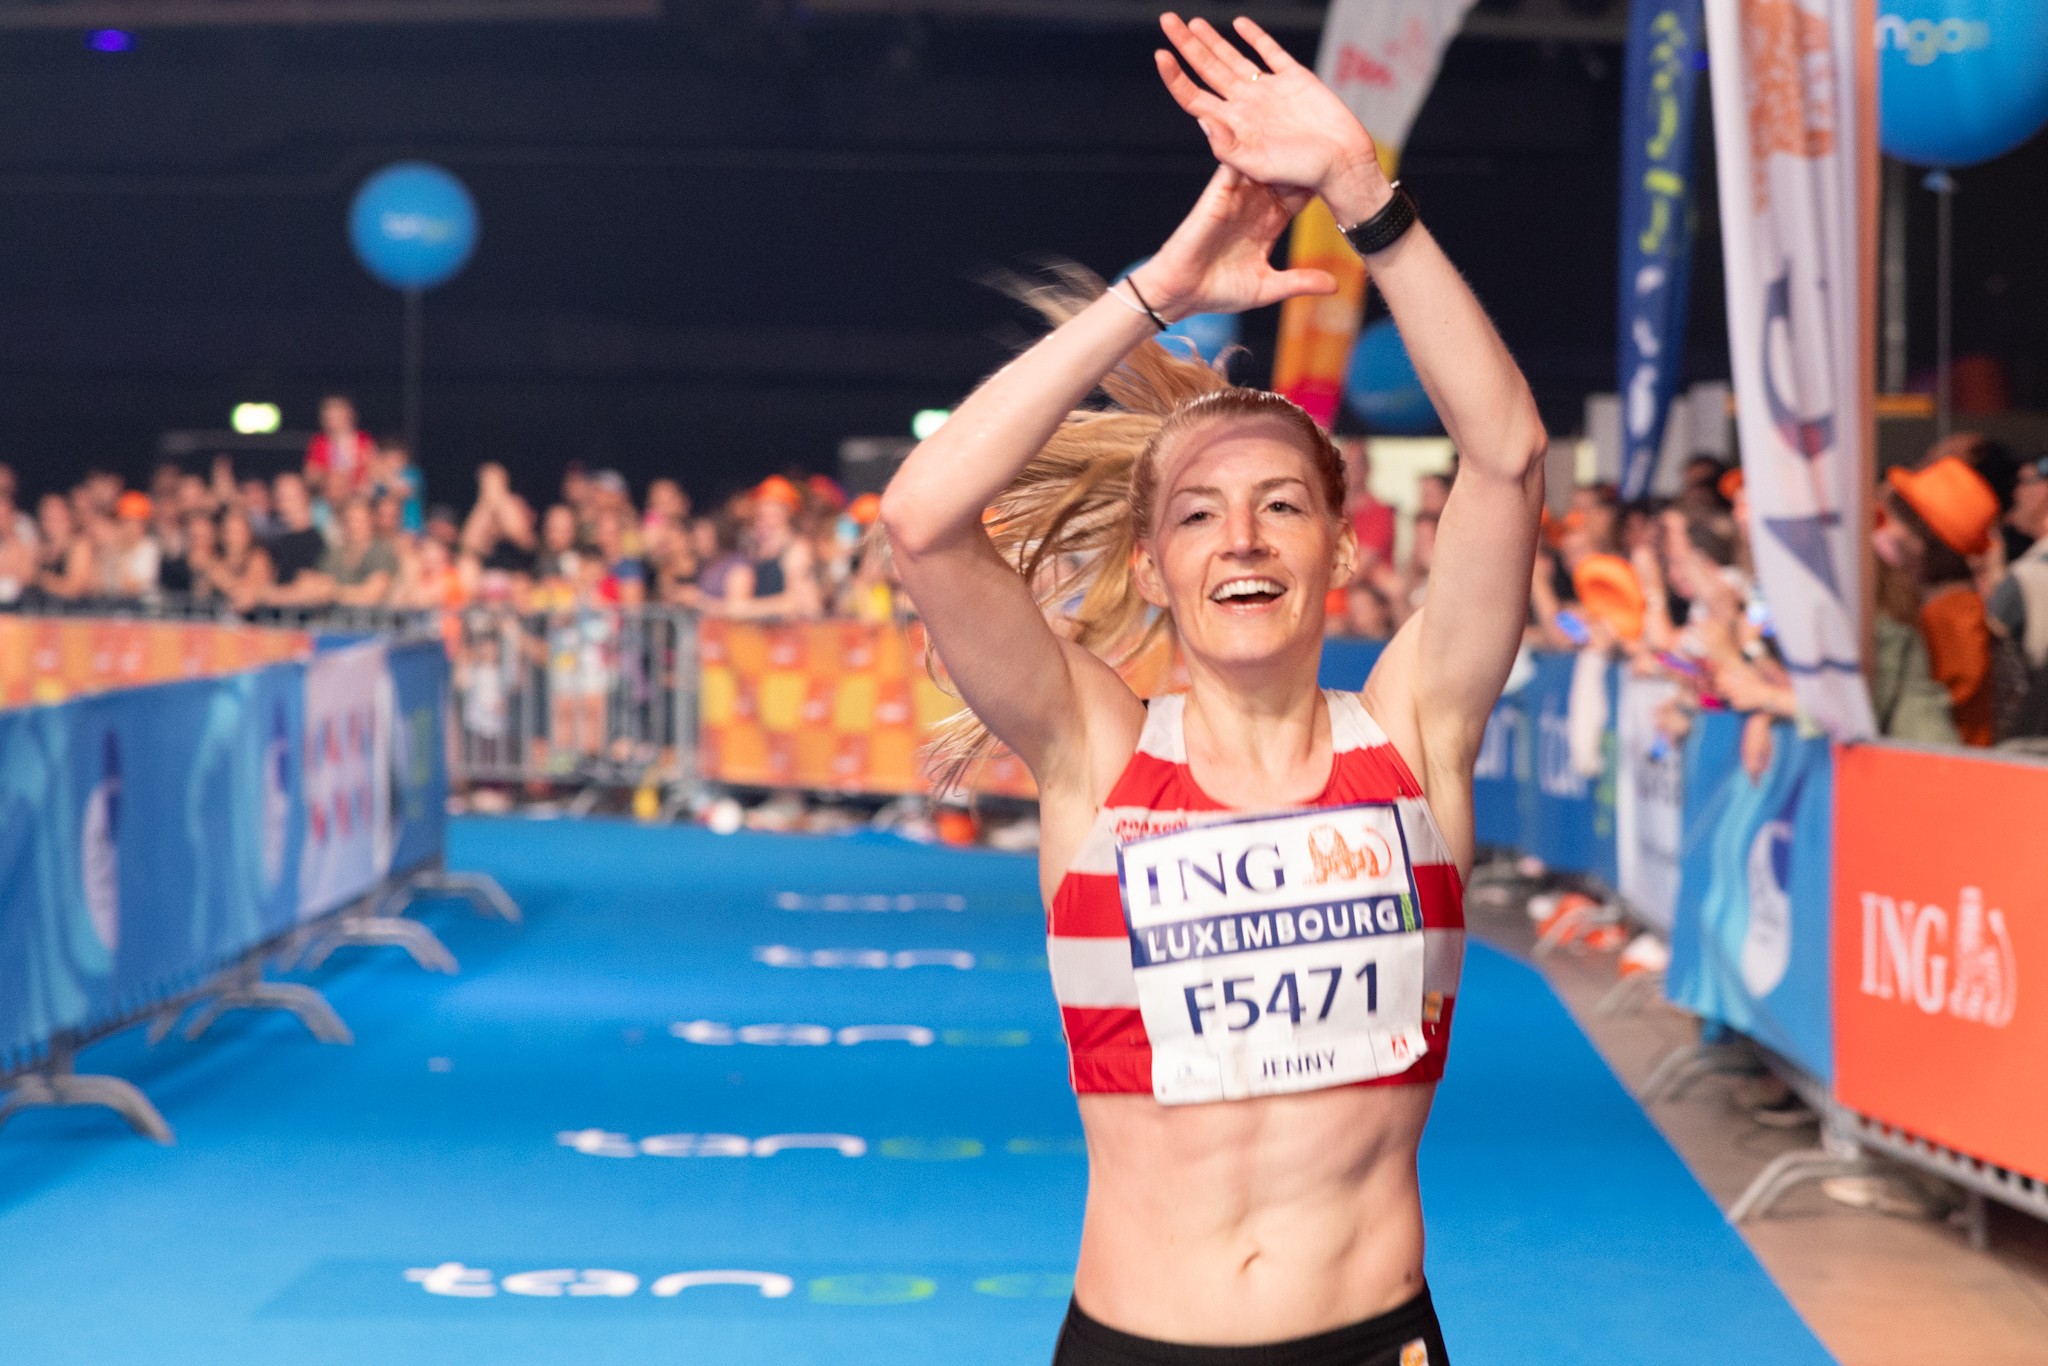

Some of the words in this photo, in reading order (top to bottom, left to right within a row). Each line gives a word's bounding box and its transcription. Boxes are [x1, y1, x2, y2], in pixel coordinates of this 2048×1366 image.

[1145, 842, 1288, 908] ING
[1147, 897, 1400, 964] LUXEMBOURG
[1858, 889, 1949, 1015] ING
[1182, 959, 1380, 1037] F5471
[1261, 1050, 1337, 1079] JENNY
